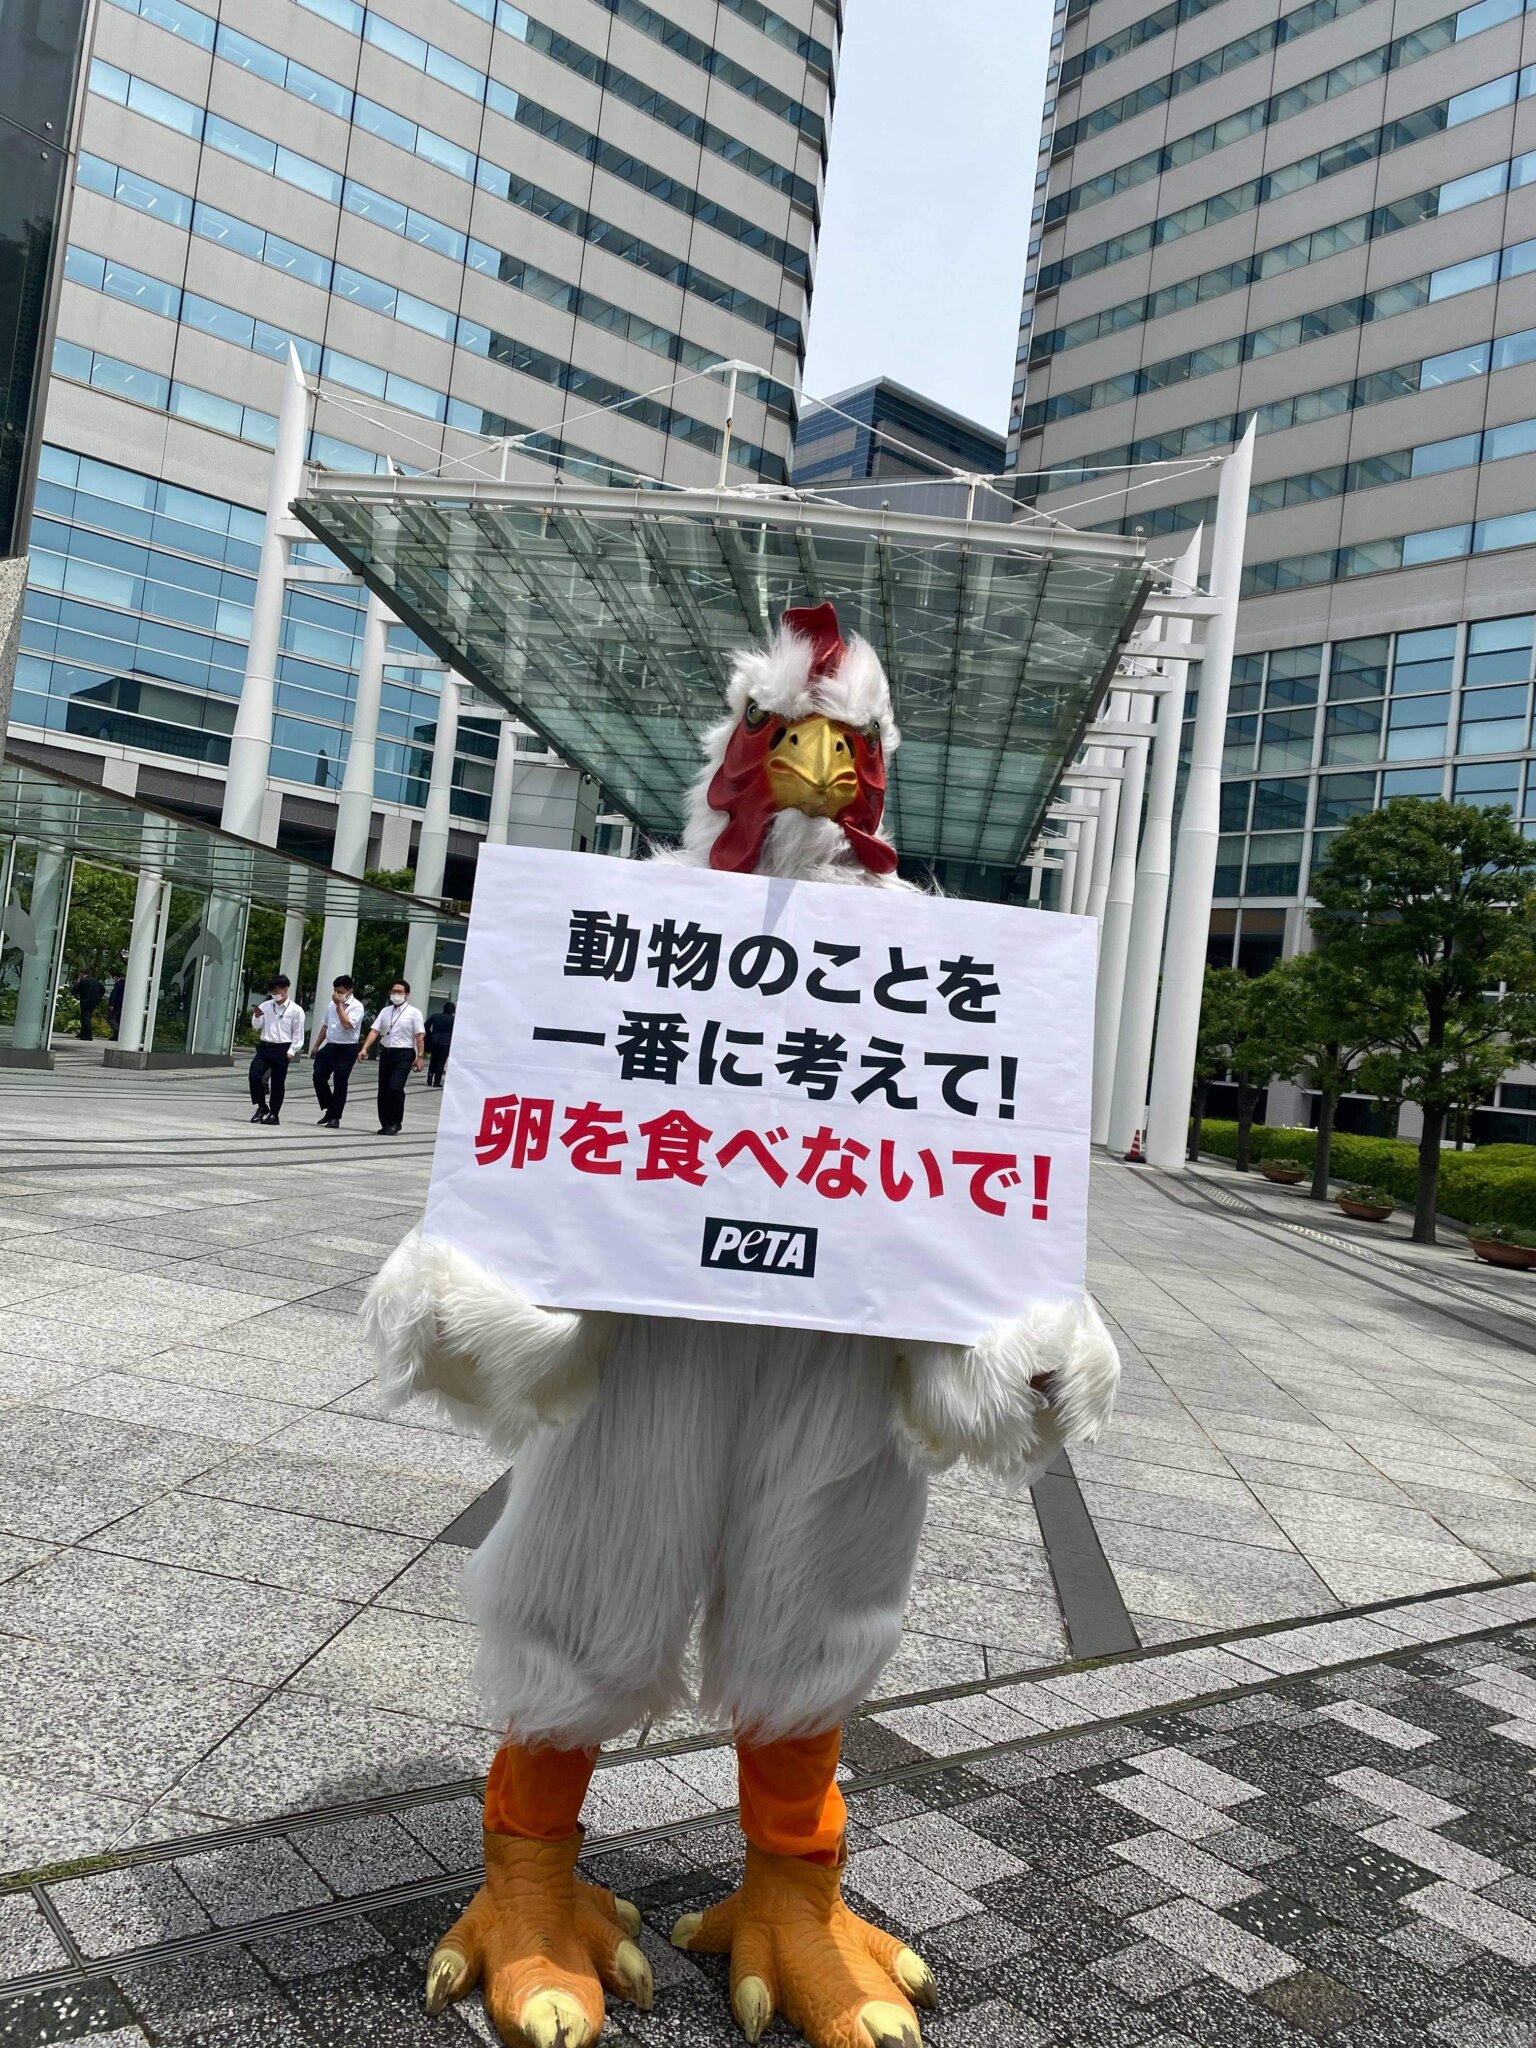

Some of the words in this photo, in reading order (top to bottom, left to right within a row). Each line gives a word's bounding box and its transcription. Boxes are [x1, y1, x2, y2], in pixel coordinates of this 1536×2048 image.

[563, 909, 1000, 1023] 動物のことを
[532, 1010, 1018, 1119] 一番に考えて!
[474, 1093, 1051, 1220] 卵を食べないで!
